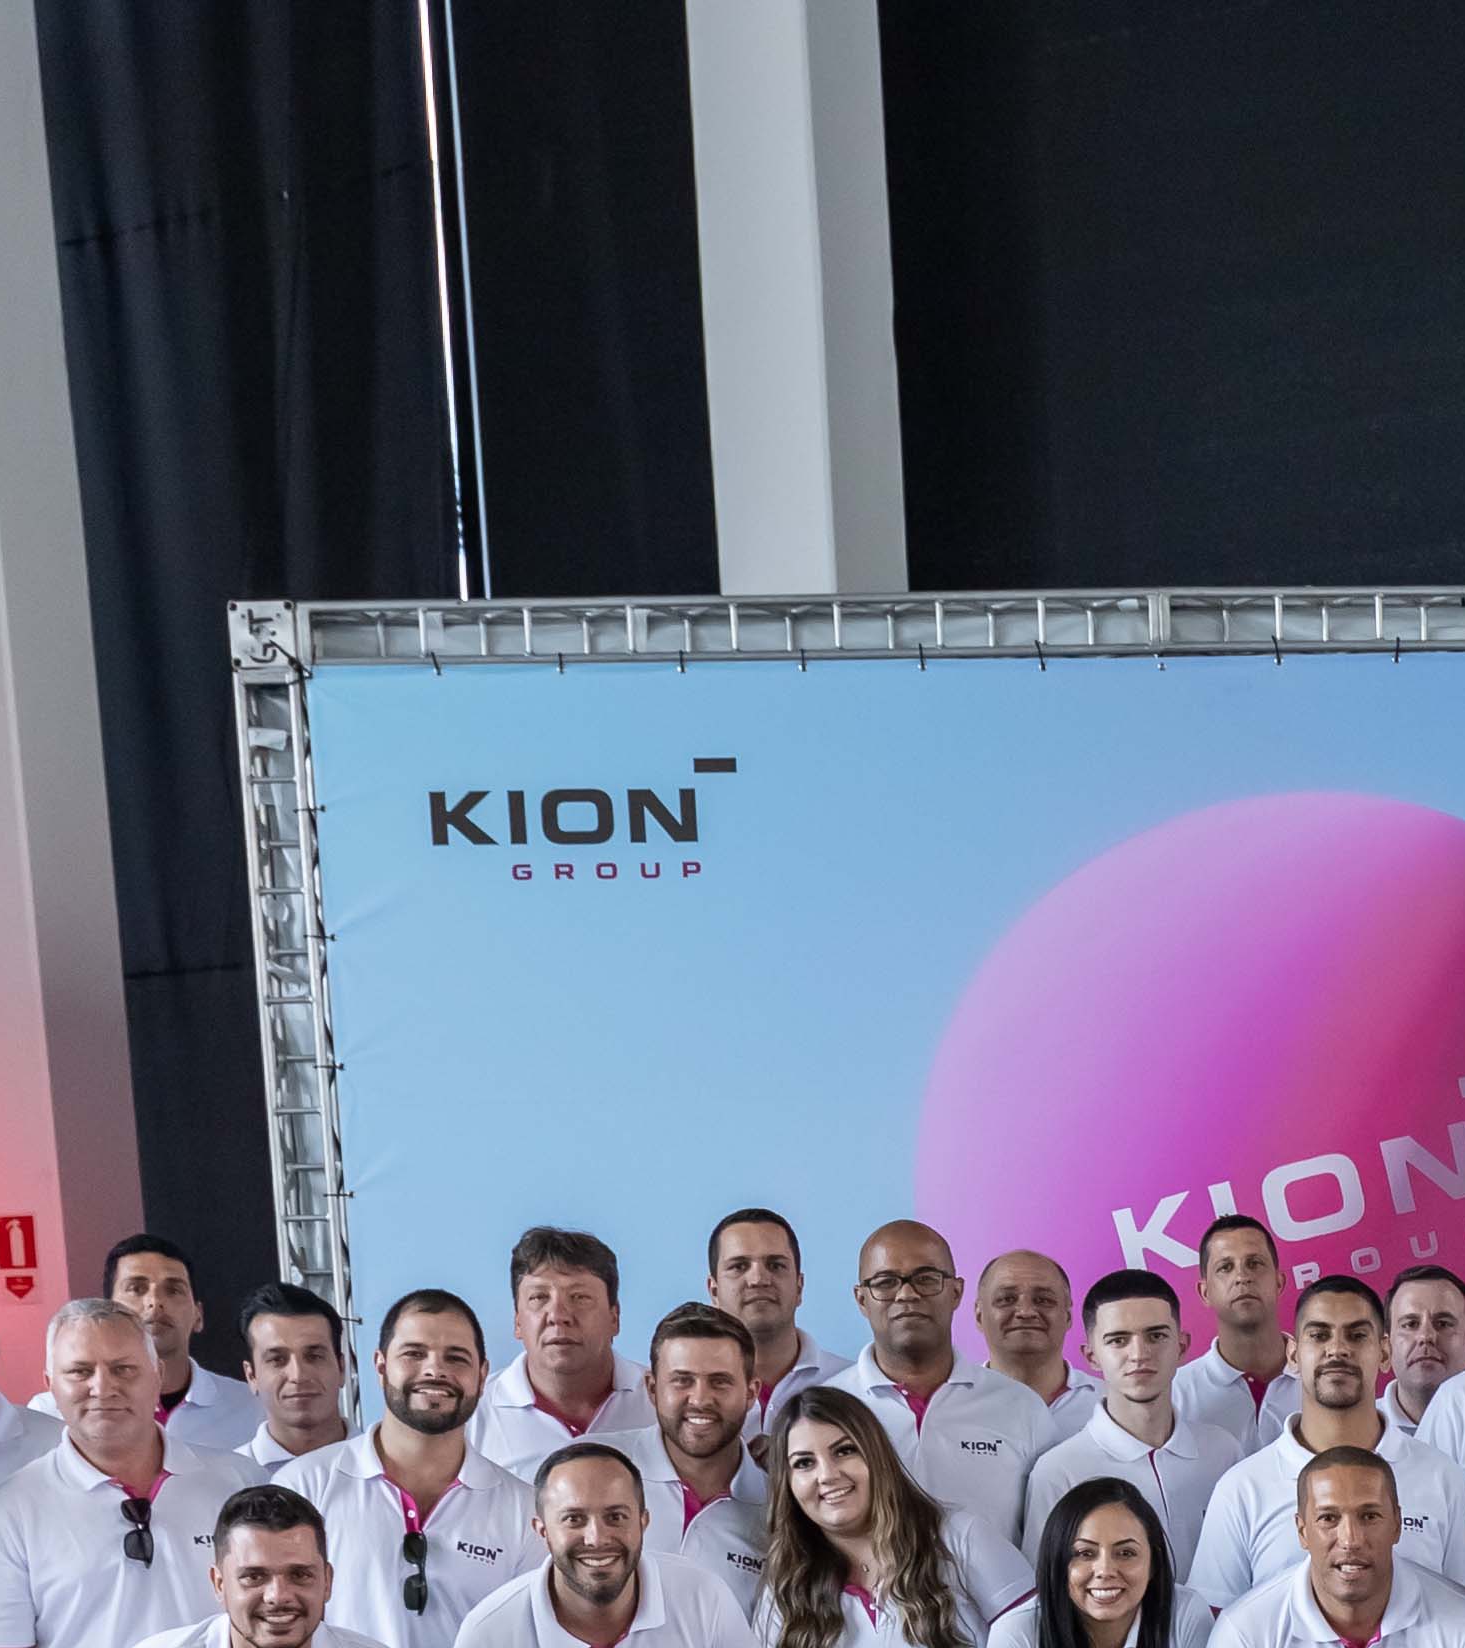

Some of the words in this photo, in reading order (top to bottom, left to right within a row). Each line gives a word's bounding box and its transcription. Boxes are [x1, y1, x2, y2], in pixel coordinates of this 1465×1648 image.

[428, 787, 699, 846] KION
[511, 861, 702, 880] GROUP
[961, 1441, 997, 1452] KION
[1403, 1517, 1424, 1528] ON
[193, 1535, 215, 1544] KI
[457, 1541, 497, 1561] KION
[726, 1552, 764, 1571] KION
